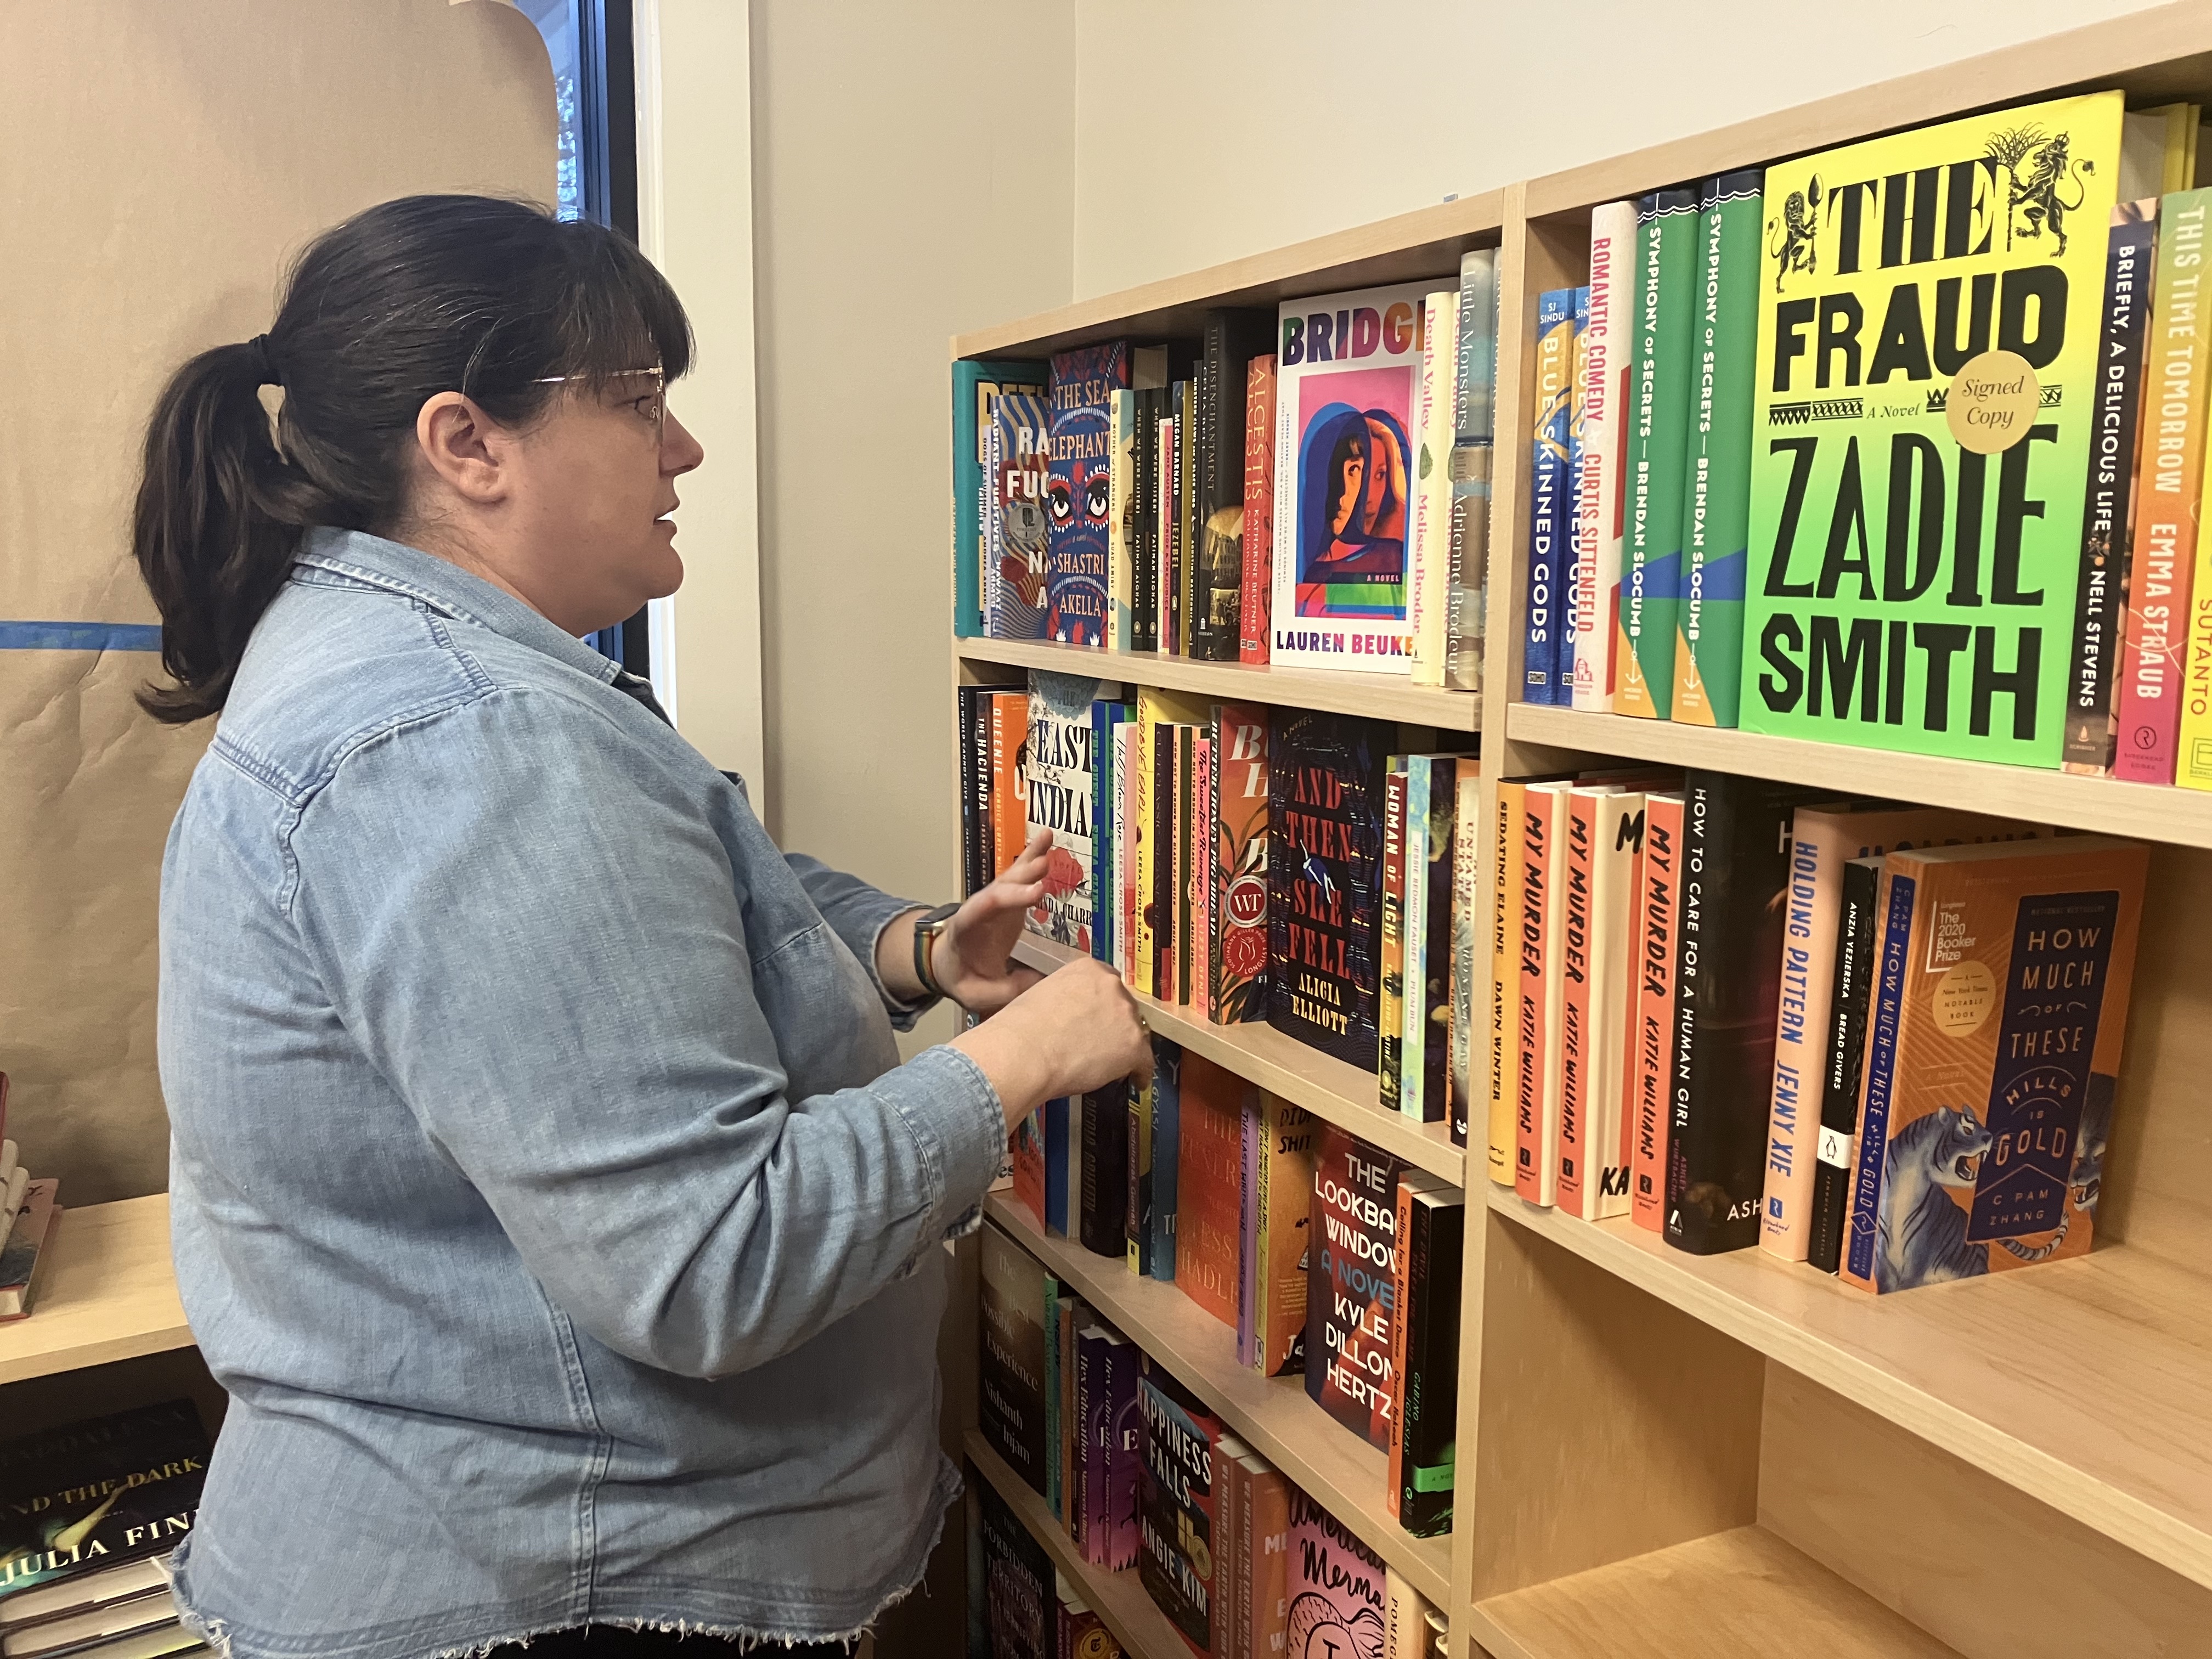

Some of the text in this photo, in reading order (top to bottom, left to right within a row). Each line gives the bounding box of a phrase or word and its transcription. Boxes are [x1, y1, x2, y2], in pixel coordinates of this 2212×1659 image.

[1827, 156, 1999, 275] THE
[1457, 270, 1476, 430] Little Monsters
[1587, 237, 1611, 422] ROMANTIC COMEDY
[1773, 264, 2068, 392] FRAUD
[2152, 205, 2205, 495] THIS TIME TOMORROW
[1421, 308, 1436, 430] Death Valley
[1962, 376, 2024, 402] Signed
[1207, 360, 1217, 491] DISENCHANTMENT
[1252, 368, 1266, 500] ALCESTIS
[1630, 226, 1662, 636] SYMPHONY OF SECRETS BRENDAN SLOCUMB
[1689, 213, 1722, 641] SYMPHONY OF SECRETS BRENDAN SLOCUMB
[1967, 407, 2014, 429] Copy
[1531, 336, 1559, 644] BLUE-SKINNED GODS
[1763, 424, 2057, 606] ZADIE
[1058, 554, 1104, 576] SHASTRI
[1251, 509, 1260, 578] KATHARINE
[1414, 494, 1428, 634] Melissa Broder
[1577, 453, 1602, 632] CURTIS SITTENFELD
[1060, 595, 1102, 618] AKELLA
[2080, 570, 2107, 707] NELL STEVENS
[2137, 523, 2177, 698] EMMA STRAUB
[1759, 613, 2041, 740] SMITH
[993, 707, 1003, 775] QUEENIE
[1037, 719, 1092, 773] EAST
[1138, 696, 1148, 771] GOODBYE
[978, 738, 988, 810] HACIENDA
[1294, 765, 1342, 810] AND
[1197, 750, 1207, 895] The Sweetest Revenge
[1286, 810, 1352, 863] THEN
[1384, 785, 1400, 948] WOMAN OF LIGHT
[1465, 821, 1474, 922] UNTAMED
[1496, 800, 1508, 955] SEDATING ELAINE
[1521, 811, 1544, 977] MY MURDER
[1565, 814, 1588, 984] MY MURDER
[1644, 823, 1671, 997] MY MURDER
[1781, 840, 1818, 1045] HOLDING PATTERN
[1900, 905, 1910, 932] PAM
[1937, 936, 1976, 950] Booker
[2028, 928, 2101, 951] HOW
[1289, 922, 1351, 980] FELL
[1842, 902, 1858, 998] ANZIA YEZIERSKA
[1935, 950, 1961, 962] Prize
[2022, 961, 2094, 990] MUCH
[1291, 994, 1347, 1036] ELLIOTT
[1298, 973, 1341, 1007] ALICIA
[1950, 1011, 1974, 1020] BOOK
[1493, 980, 1503, 1101] DAWN WINTER
[1520, 995, 1536, 1134] KATIE WILLIAMS
[1564, 1001, 1579, 1143] KATIE WILLIAMS
[1833, 1013, 1847, 1090] BREAD GIVERS
[2011, 1026, 2083, 1059] THESE
[1640, 1015, 1660, 1160] KATIE WILLIAMS
[1770, 1059, 1798, 1177] JENNY XIE
[2006, 1077, 2072, 1105] HILLS
[1344, 1152, 1386, 1194] THE
[1679, 1155, 1688, 1192] ASHLEY
[1996, 1127, 2067, 1166] GOLD
[1398, 1206, 1407, 1244] Calling
[1396, 1278, 1404, 1321] Blanket
[1398, 1268, 1403, 1276] a
[1325, 1321, 1393, 1381] DILLON
[1335, 1291, 1389, 1345] KYLE
[987, 1330, 1039, 1391] Experience
[1327, 1357, 1392, 1420] HERTZ
[1393, 1370, 1401, 1403] Oscar
[1413, 1372, 1421, 1421] GABINO
[1080, 1353, 1089, 1463] Hex Education
[1137, 1377, 1212, 1485] HAPPINESS
[1403, 1396, 1412, 1455] IGLESIAS
[58, 1455, 203, 1504] THE DARK
[1149, 1436, 1190, 1509] FALLS
[984, 1518, 1042, 1598] FORBIDDEN
[1142, 1515, 1207, 1617] ANGIE KIM
